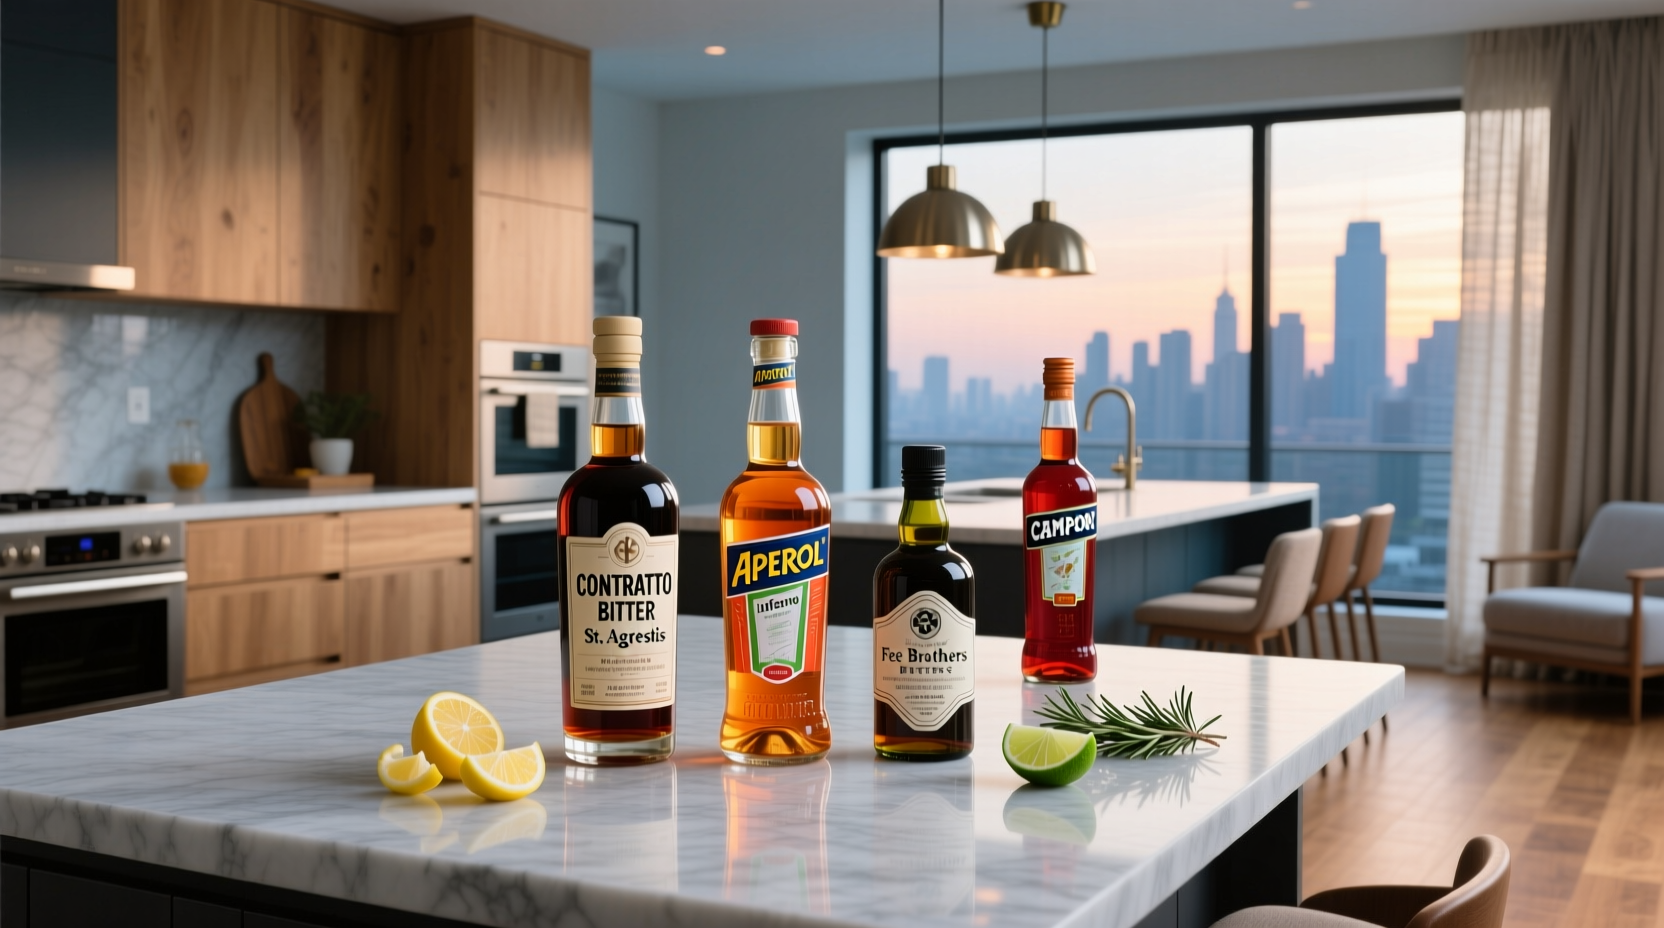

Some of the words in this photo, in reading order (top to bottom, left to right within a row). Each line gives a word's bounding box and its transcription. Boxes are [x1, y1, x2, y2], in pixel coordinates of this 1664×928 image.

[576, 572, 672, 597] CONTRATTO
[598, 600, 656, 621] BITTER
[607, 627, 666, 648] Agrestis
[881, 646, 903, 662] Fee
[907, 647, 967, 663] Brothers
